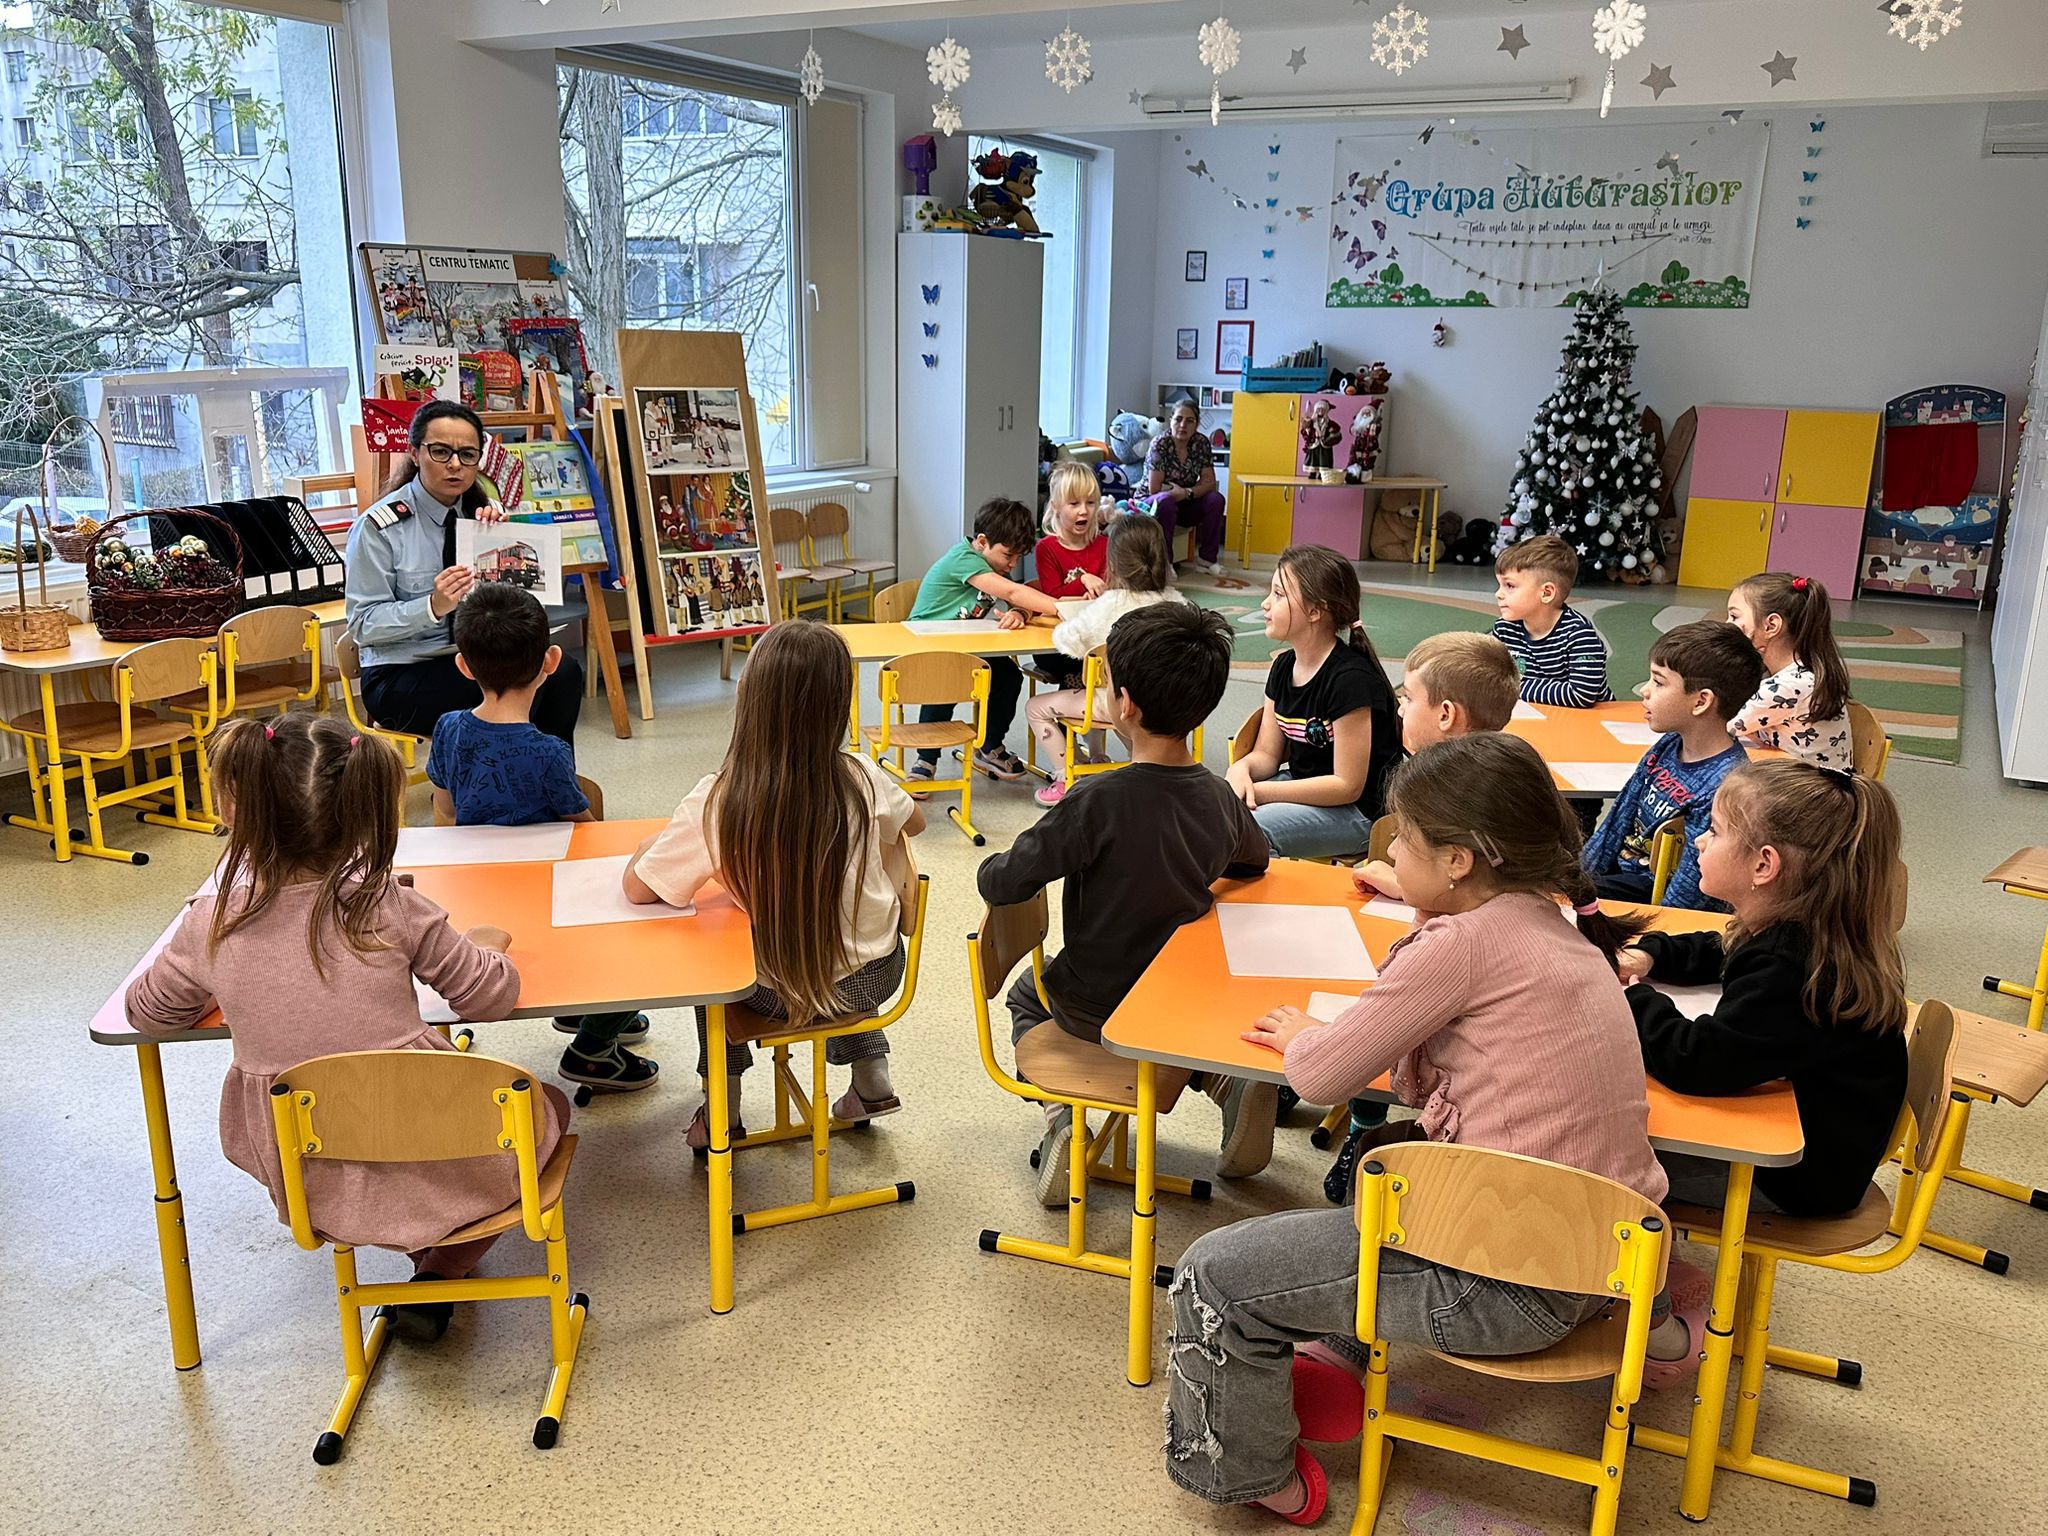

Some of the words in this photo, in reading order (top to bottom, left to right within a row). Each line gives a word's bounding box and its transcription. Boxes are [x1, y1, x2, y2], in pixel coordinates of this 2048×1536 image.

[1386, 179, 1495, 218] Grupa
[429, 256, 467, 268] CENTRU
[468, 258, 510, 270] TEMATIC
[415, 355, 454, 368] Splat!
[385, 424, 409, 436] Santa
